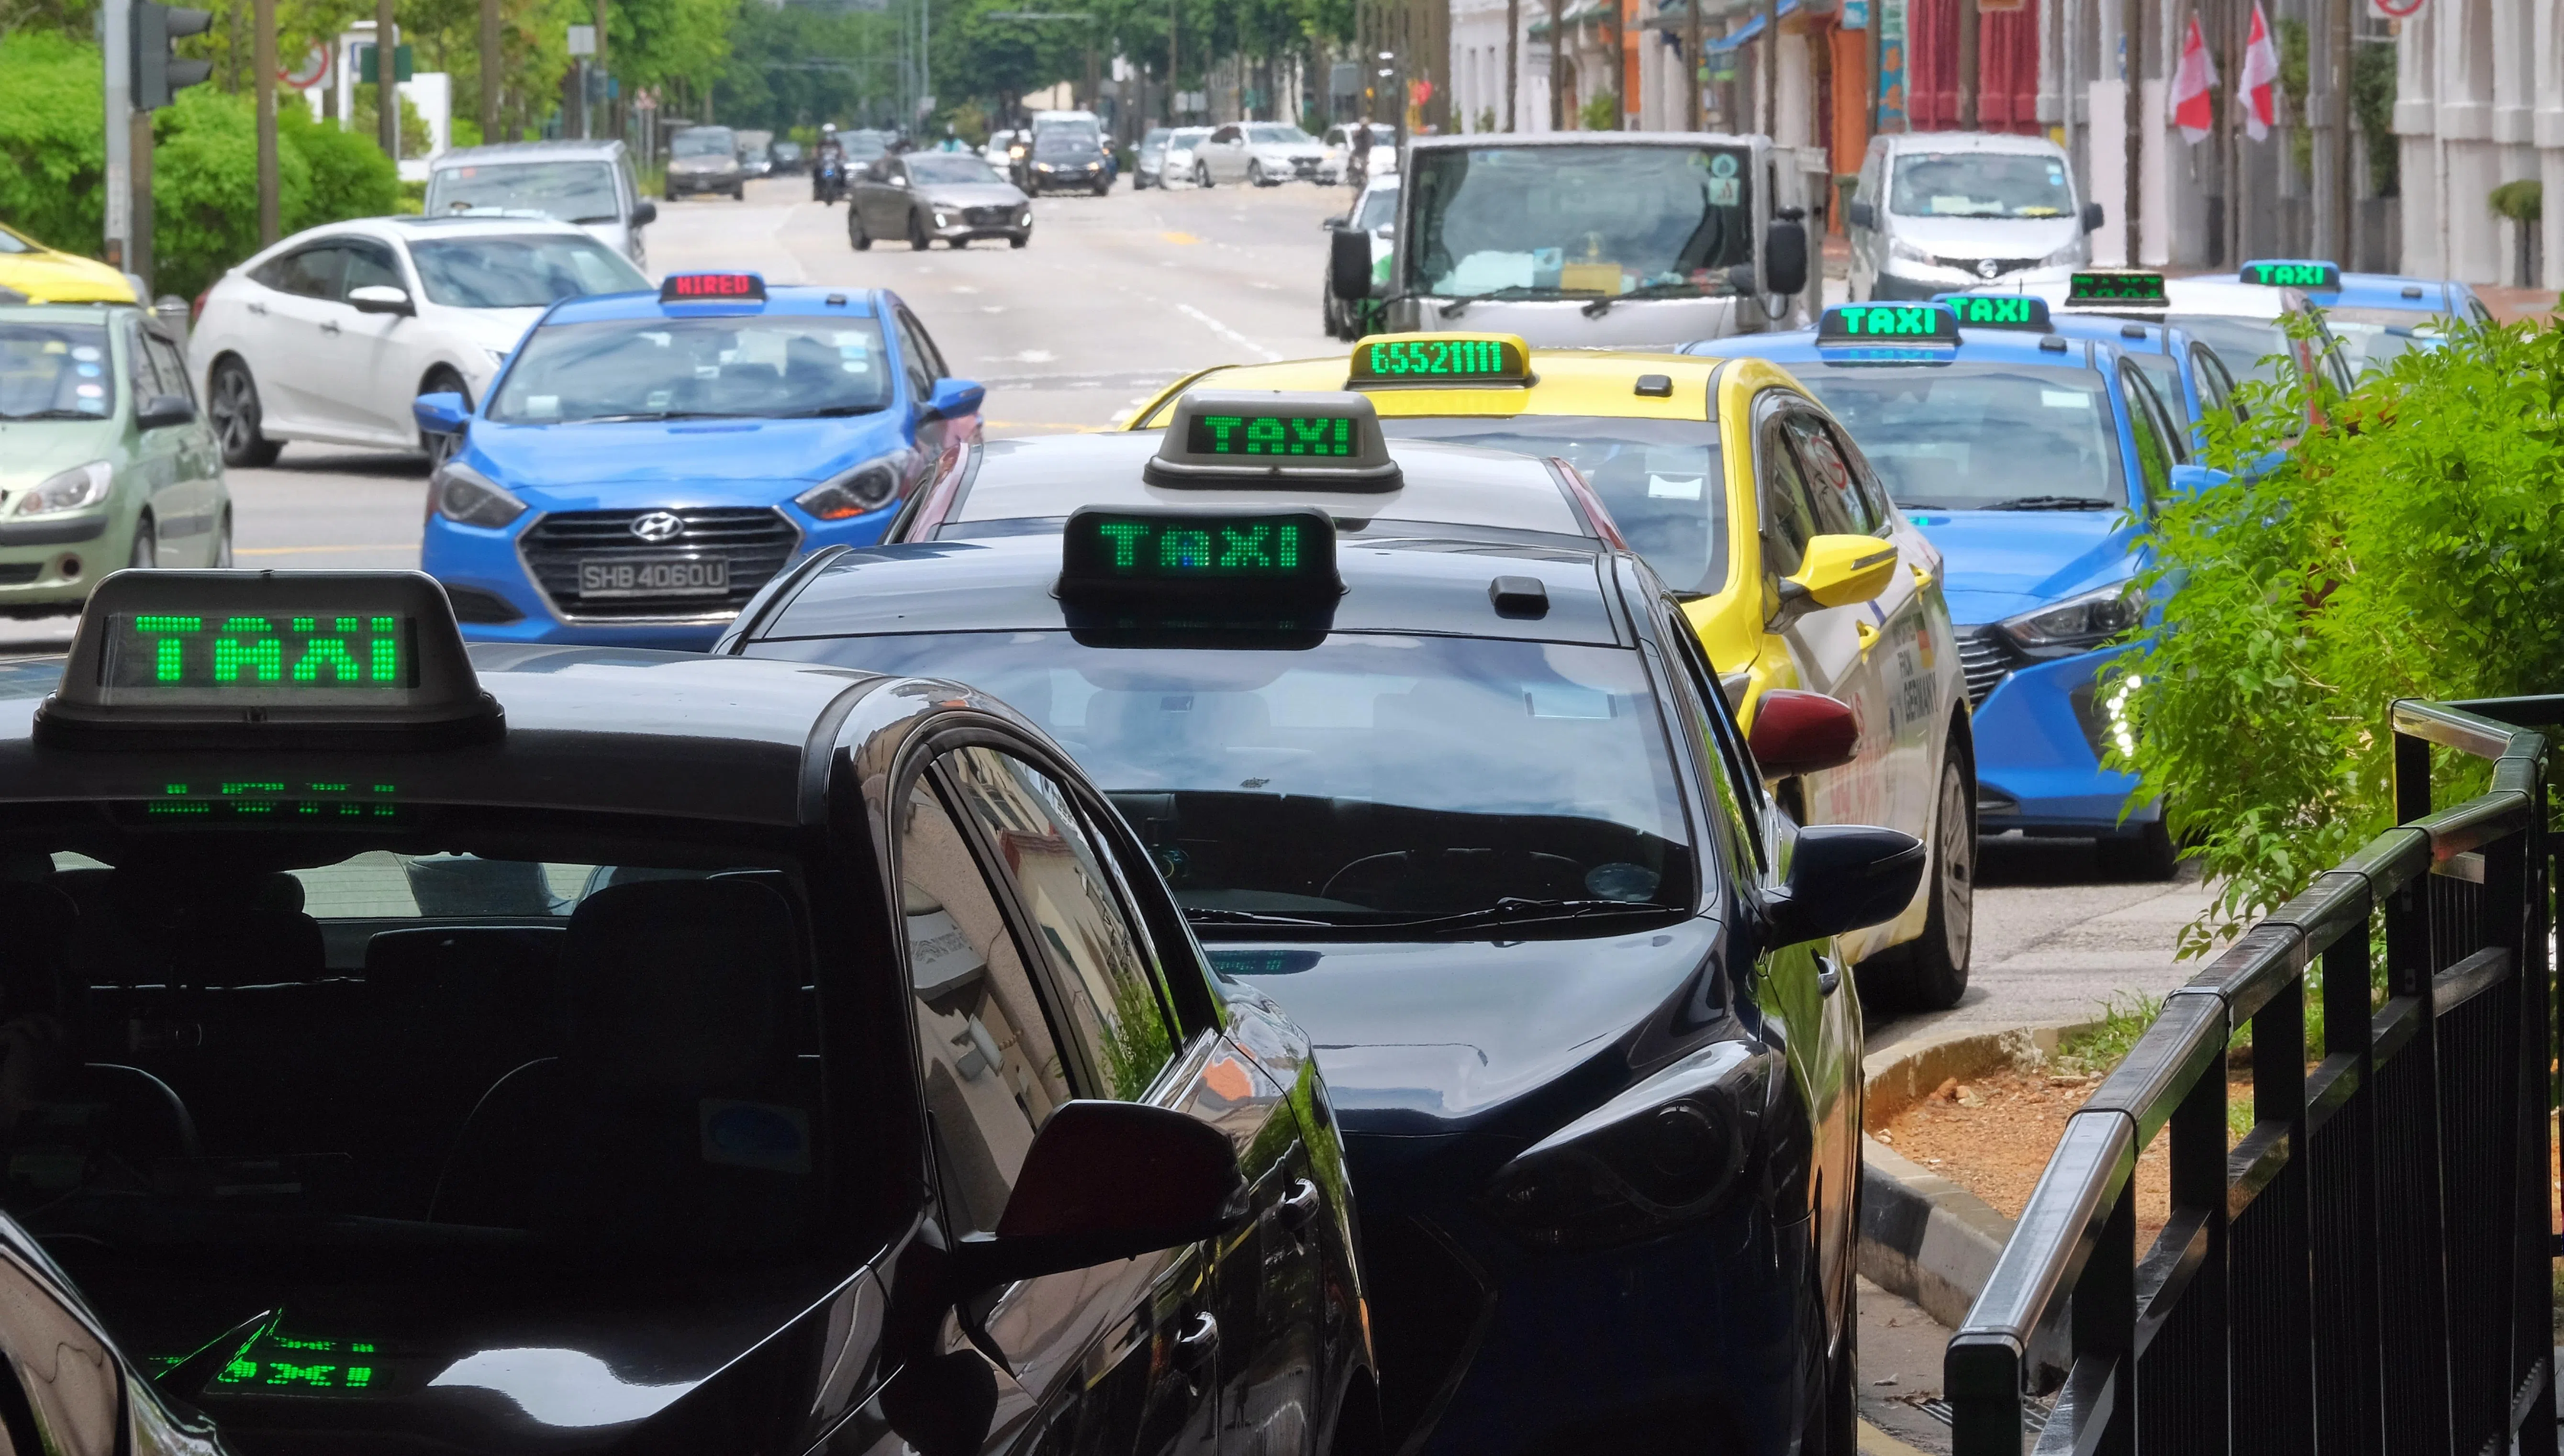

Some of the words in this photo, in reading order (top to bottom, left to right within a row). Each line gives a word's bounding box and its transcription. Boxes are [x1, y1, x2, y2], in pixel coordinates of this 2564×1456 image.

[677, 275, 749, 295] HIRED
[2255, 265, 2325, 286] TAXI
[1840, 308, 1937, 335] TAXI
[1947, 298, 2030, 323] TAXI
[1371, 341, 1502, 374] 65521111
[1204, 416, 1349, 456] TAXI
[1100, 523, 1298, 567] TAXI
[135, 616, 395, 681] TAXI
